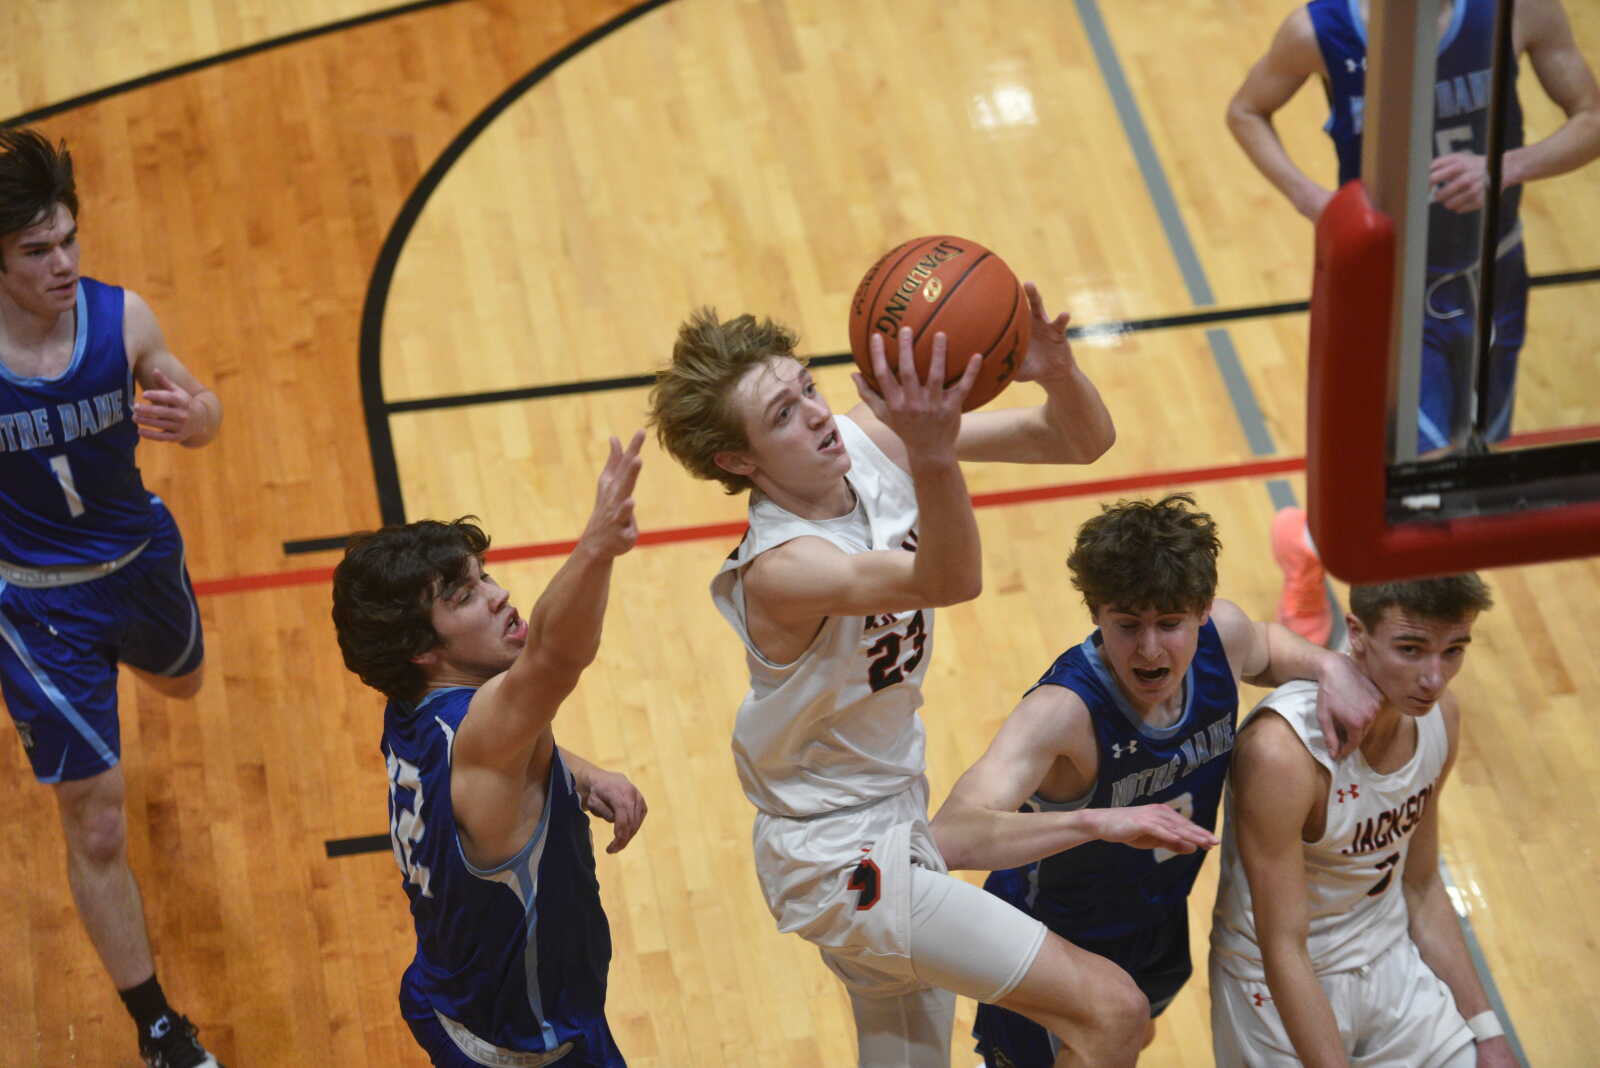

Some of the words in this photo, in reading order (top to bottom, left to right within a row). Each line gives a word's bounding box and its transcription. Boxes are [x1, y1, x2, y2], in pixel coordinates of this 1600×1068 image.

[876, 240, 965, 339] SPALDING
[57, 389, 124, 442] DAME
[49, 454, 85, 518] 1
[867, 608, 927, 693] 23
[1111, 753, 1181, 808] NOTRE
[1180, 712, 1236, 778] DAME
[1342, 784, 1433, 855] JACKSO
